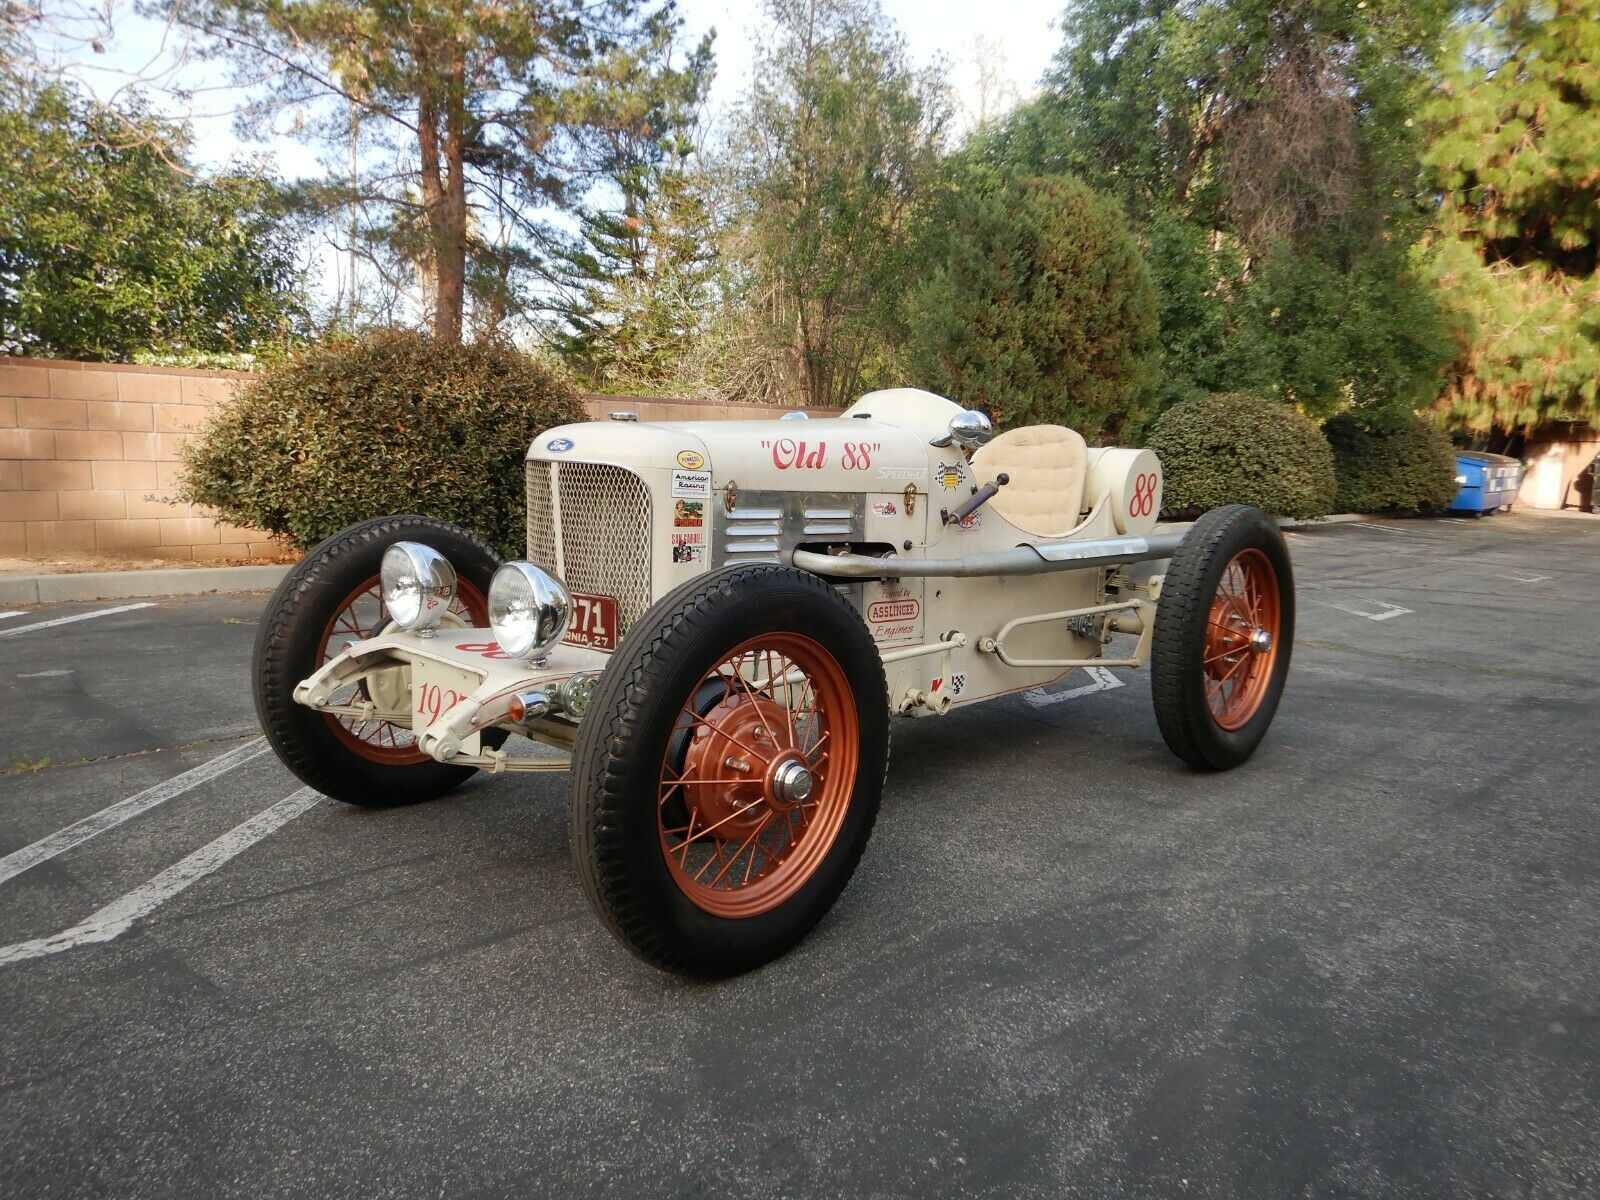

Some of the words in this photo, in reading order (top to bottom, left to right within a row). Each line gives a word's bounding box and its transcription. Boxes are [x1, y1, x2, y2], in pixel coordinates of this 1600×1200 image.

[549, 440, 569, 450] Ford
[675, 474, 709, 482] American
[678, 481, 706, 491] Racing
[1129, 473, 1157, 517] 88
[675, 518, 702, 527] POMONA
[872, 603, 915, 618] ASSLINGER
[874, 625, 914, 638] Engines
[593, 635, 609, 646] 27
